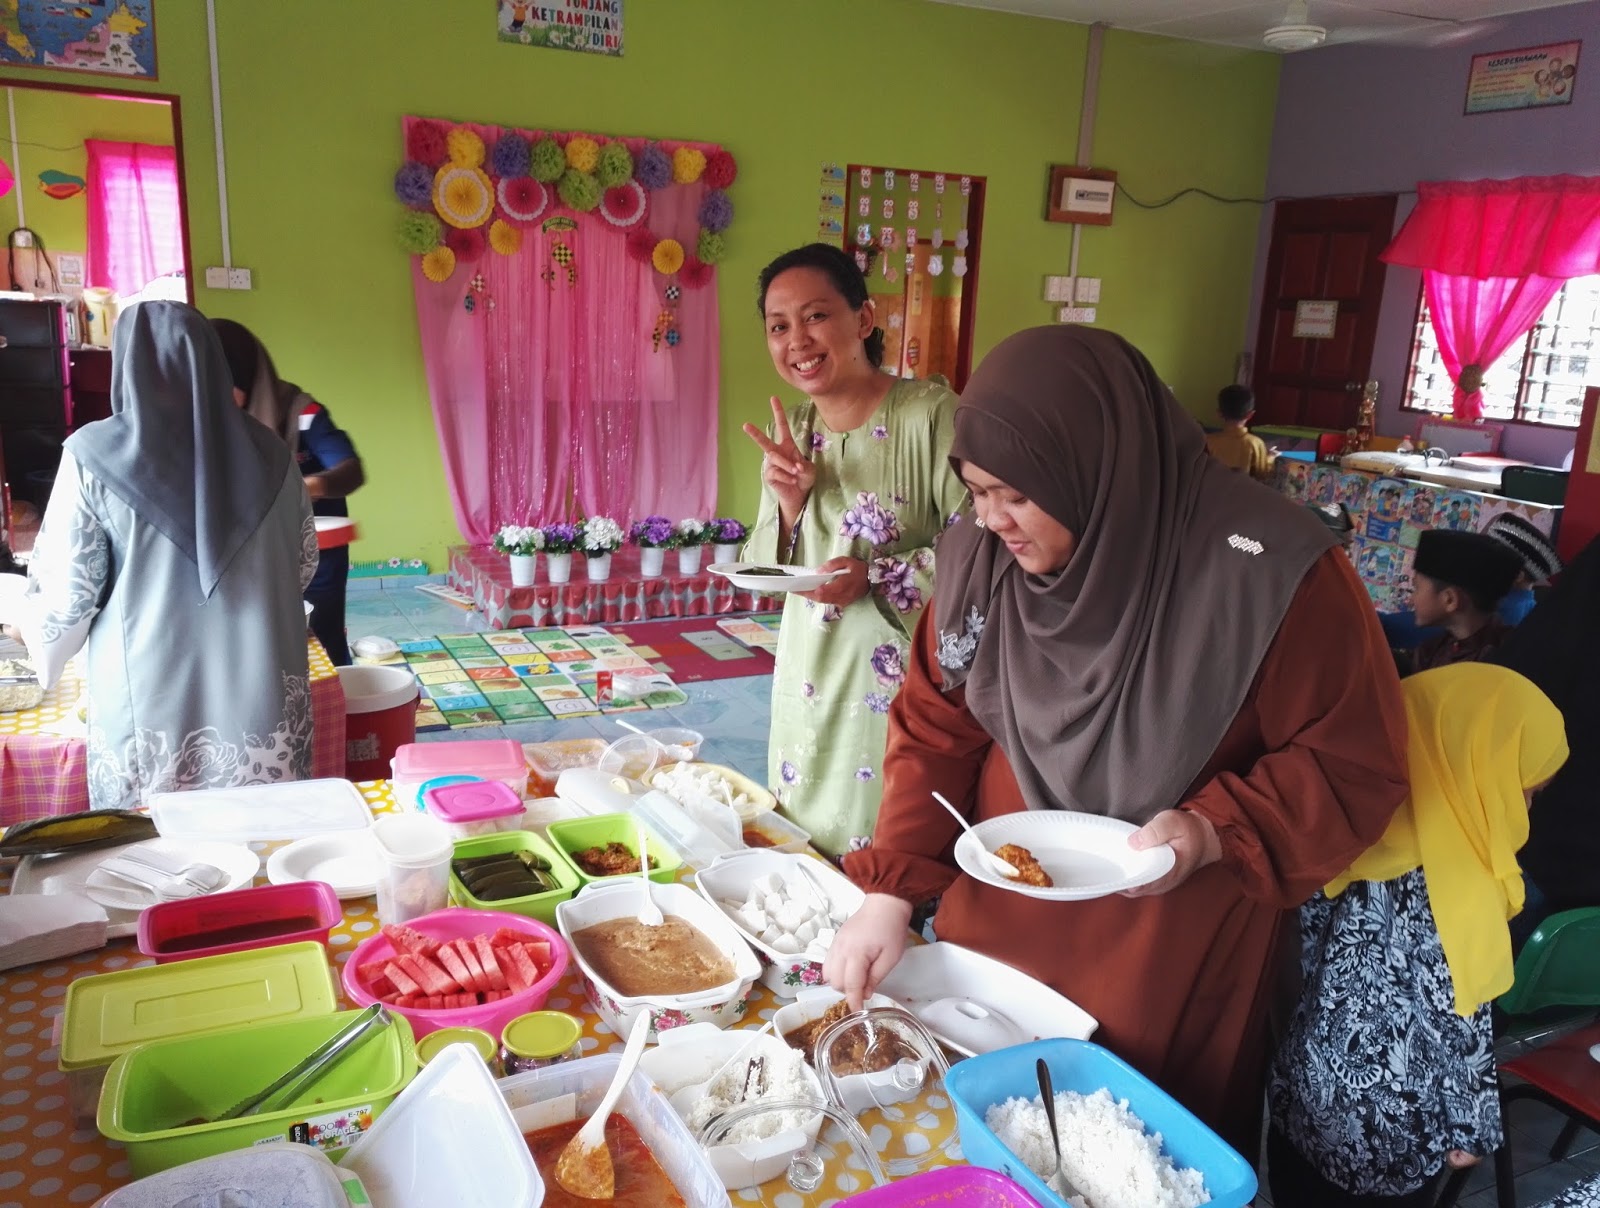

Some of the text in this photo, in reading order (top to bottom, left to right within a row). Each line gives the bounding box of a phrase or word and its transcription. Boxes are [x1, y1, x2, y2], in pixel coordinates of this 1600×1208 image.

[531, 6, 619, 31] KETRAMPILAN
[592, 32, 618, 48] DIRI
[348, 1108, 368, 1118] E-797
